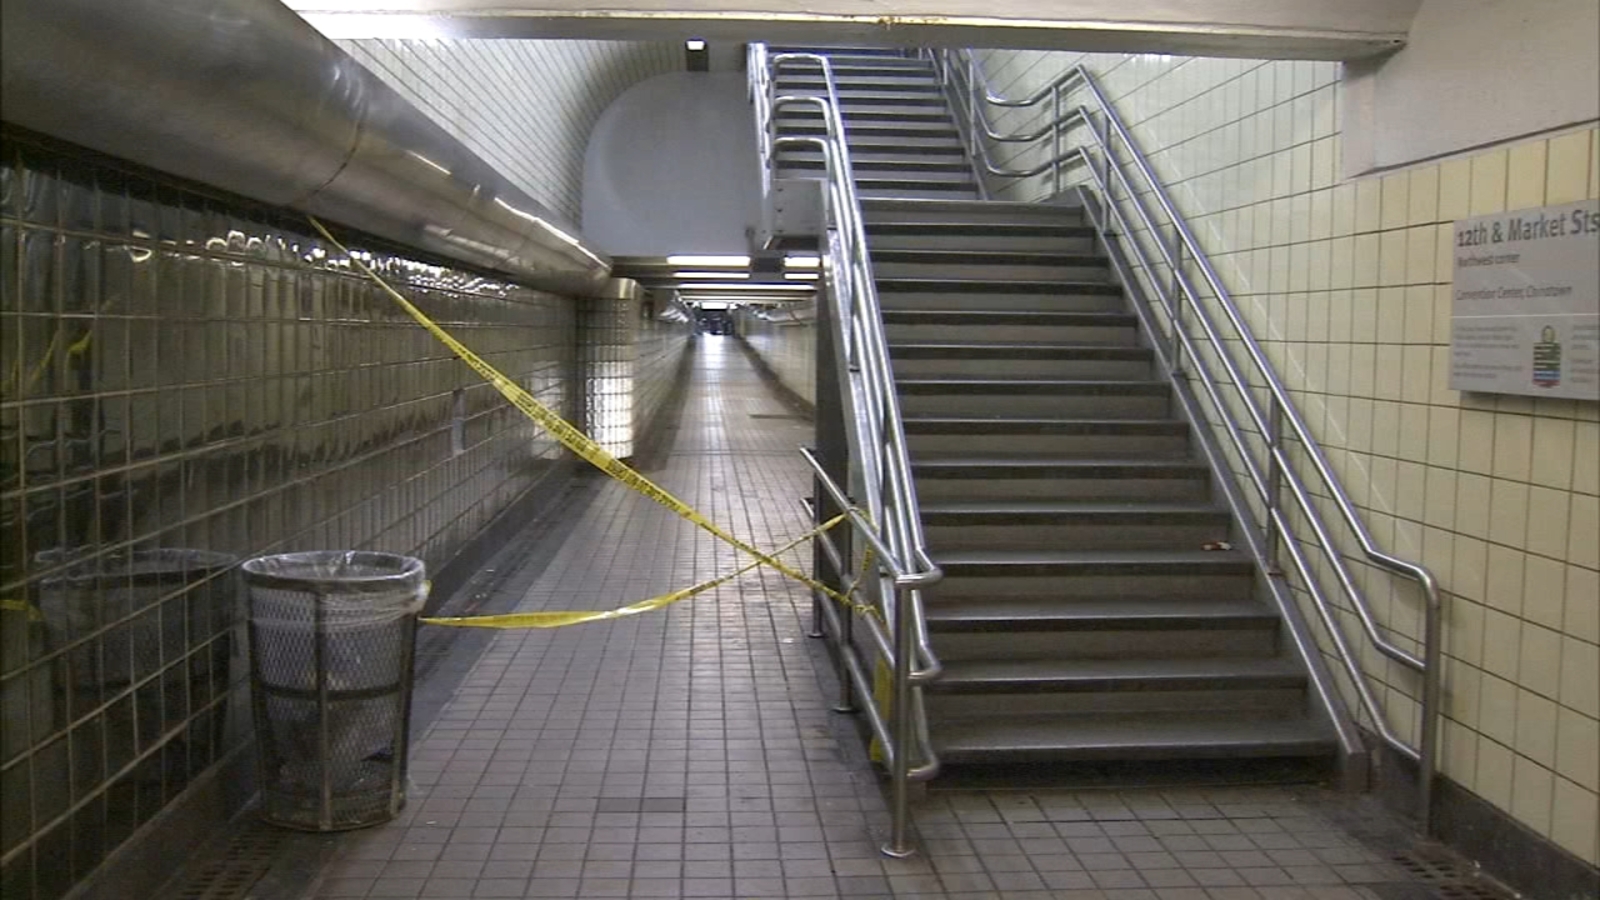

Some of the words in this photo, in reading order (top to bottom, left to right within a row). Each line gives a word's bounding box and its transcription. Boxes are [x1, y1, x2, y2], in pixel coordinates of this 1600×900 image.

[1458, 222, 1488, 247] 12th
[1491, 221, 1503, 243] &
[1508, 213, 1566, 241] Market
